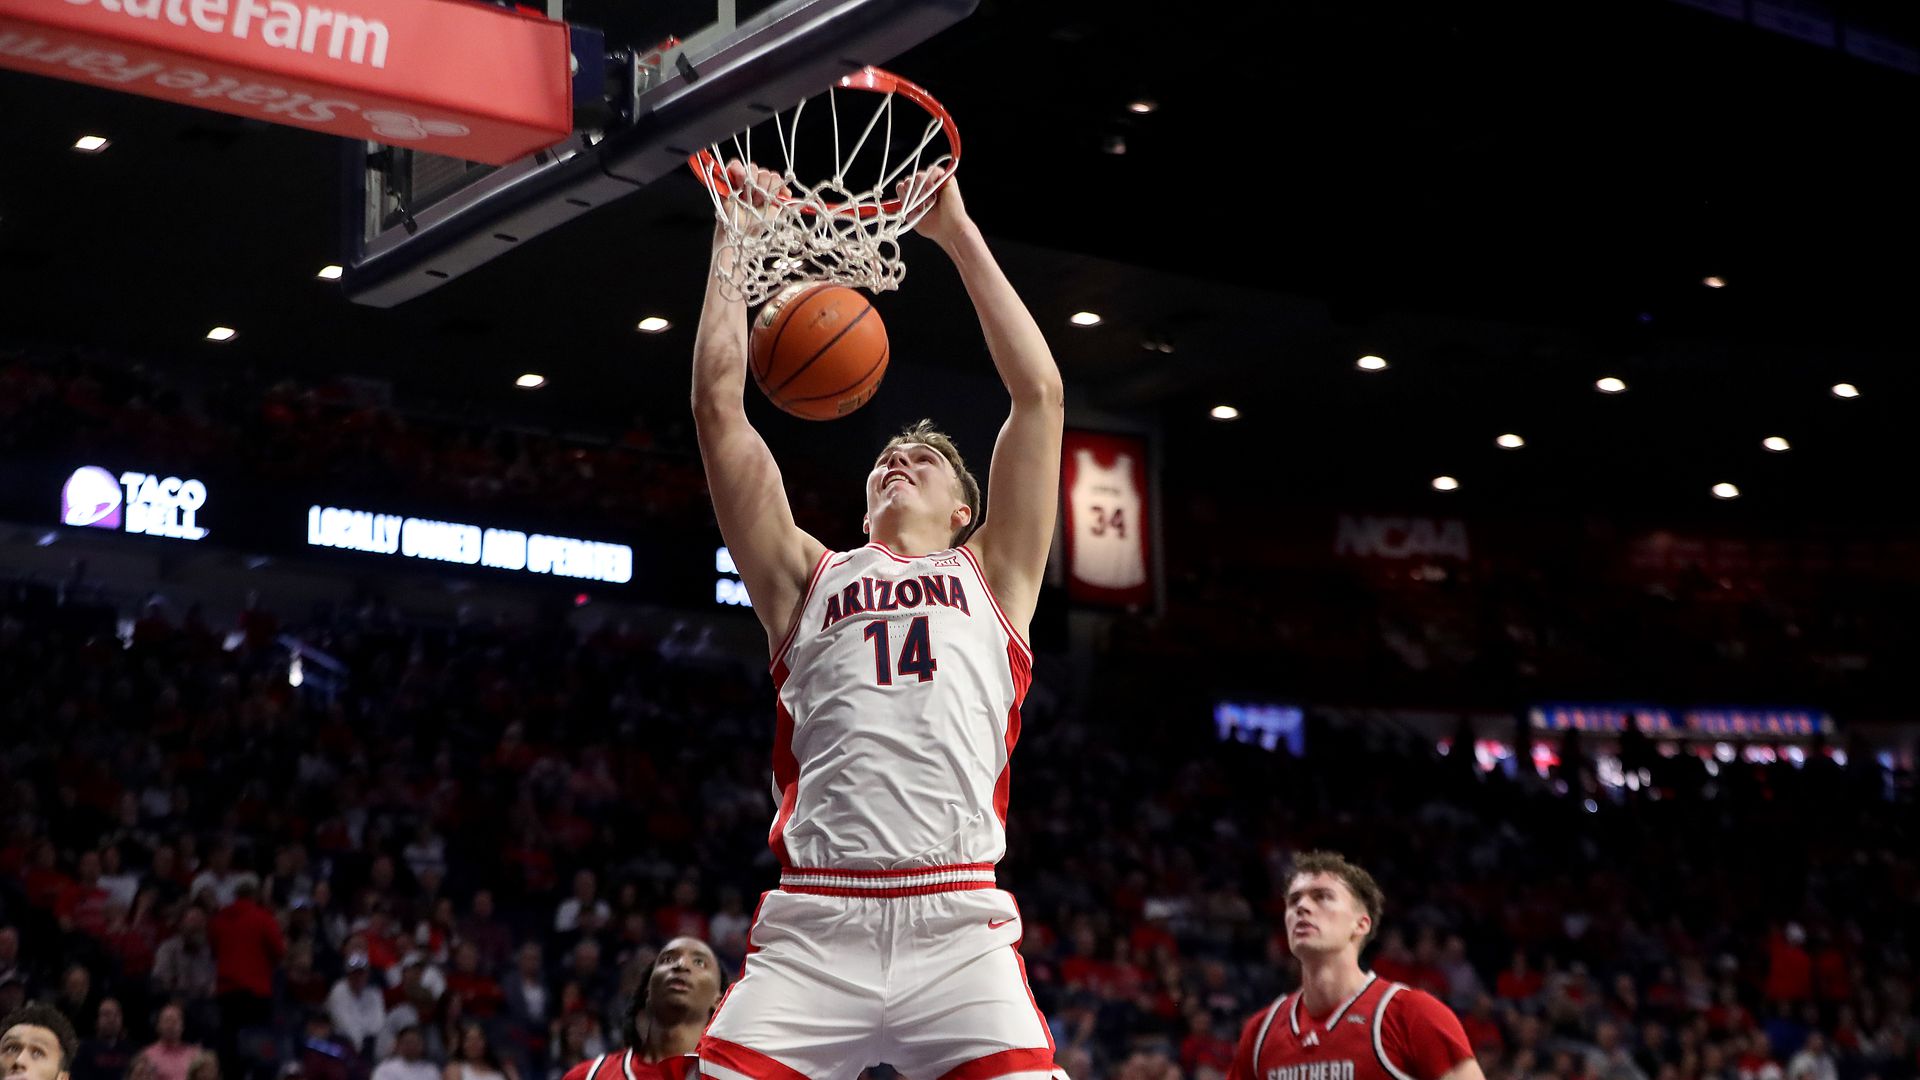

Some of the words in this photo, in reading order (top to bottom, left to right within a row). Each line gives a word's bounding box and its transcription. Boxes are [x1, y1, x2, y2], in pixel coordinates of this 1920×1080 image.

[119, 472, 207, 512] TACO
[125, 502, 209, 540] BELL
[308, 505, 402, 554] LOCALLY
[527, 533, 632, 583] OPERATED
[1090, 505, 1126, 539] 34
[1334, 514, 1470, 560] NCAA
[821, 574, 971, 632] ARIZONA
[863, 615, 937, 686] 14
